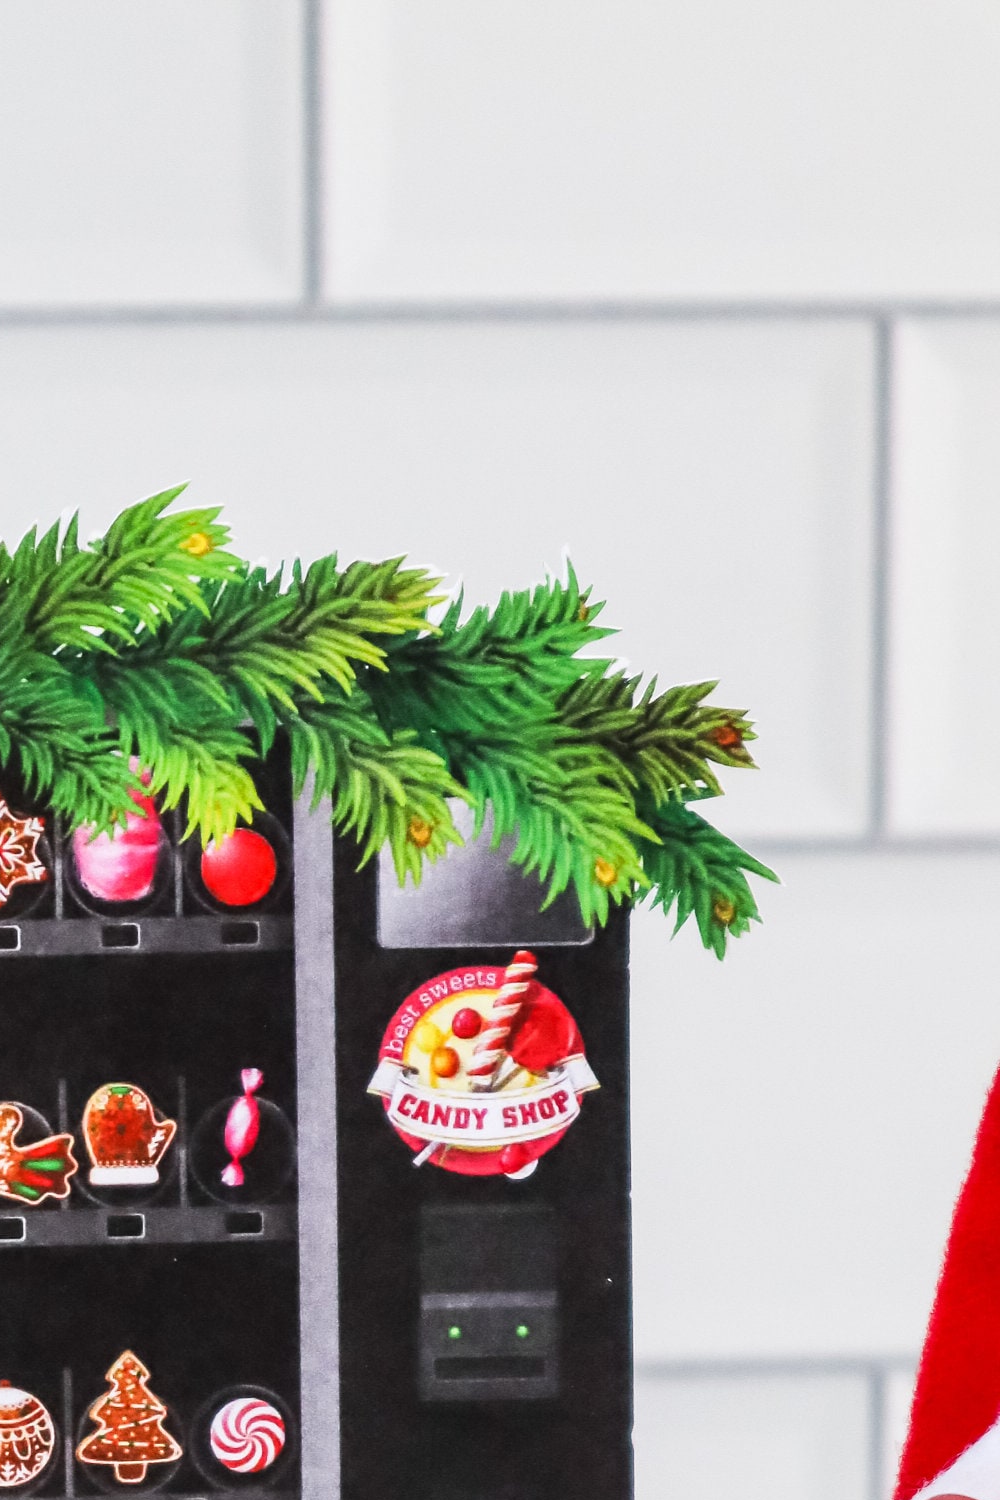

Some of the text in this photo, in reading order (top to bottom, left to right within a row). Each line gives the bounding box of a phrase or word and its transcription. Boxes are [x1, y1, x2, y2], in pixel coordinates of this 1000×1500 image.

[384, 971, 497, 1053] best sweets
[397, 1089, 570, 1130] CANDY SHOP
